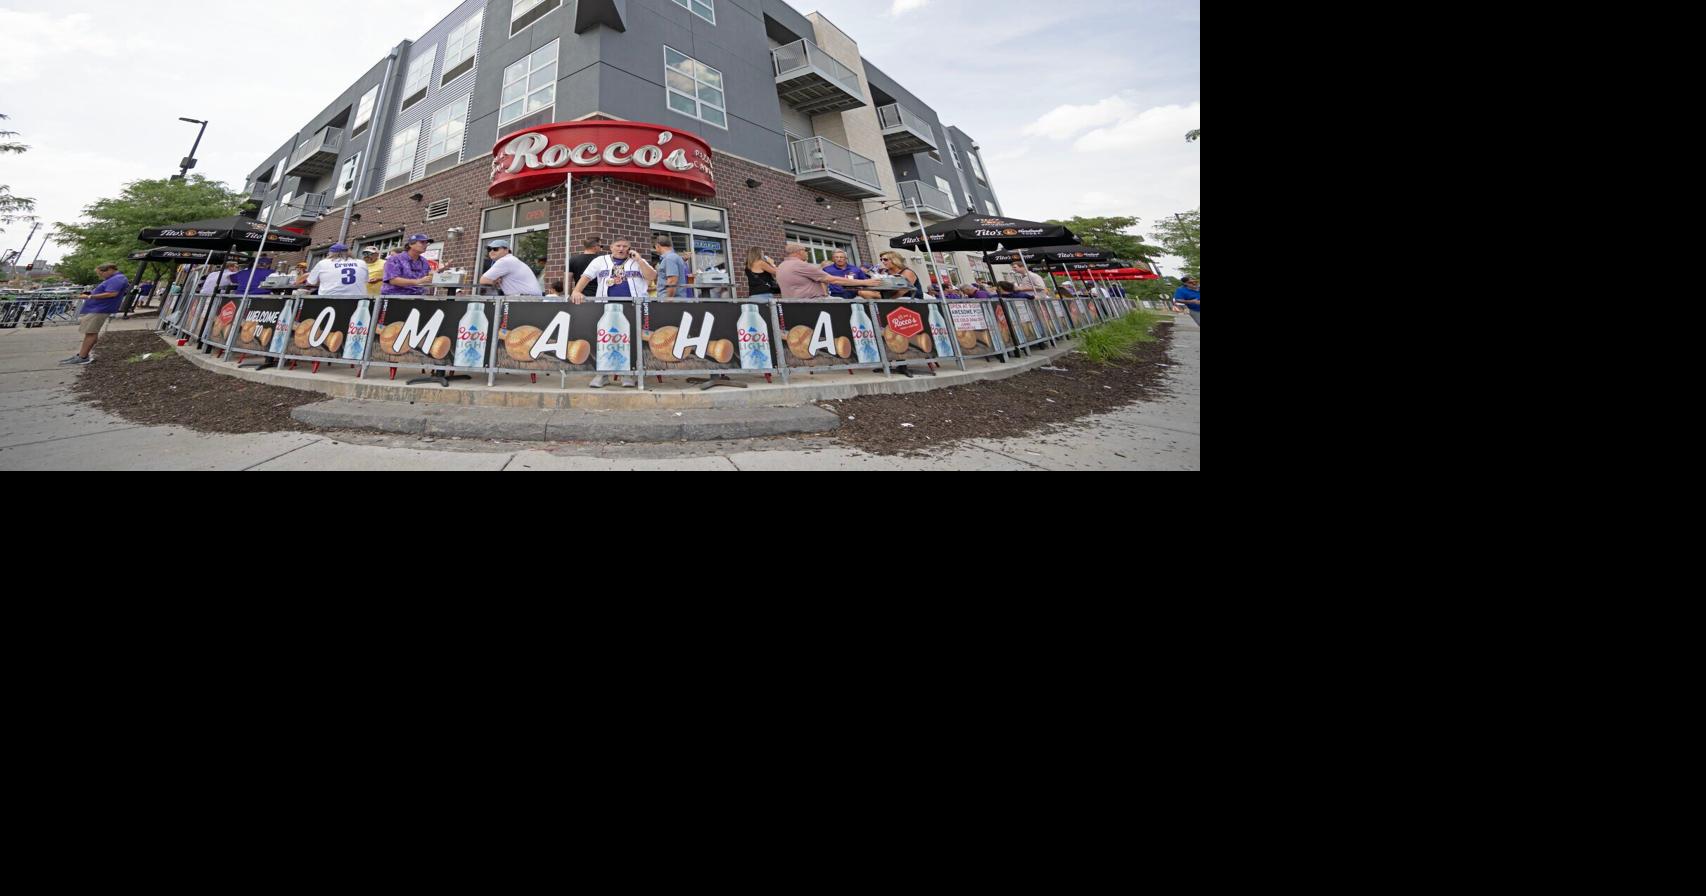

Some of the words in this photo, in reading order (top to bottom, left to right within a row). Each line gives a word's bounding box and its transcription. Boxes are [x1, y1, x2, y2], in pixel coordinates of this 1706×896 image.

[504, 131, 694, 174] Rocco's
[160, 229, 184, 237] Tito's
[902, 236, 920, 245] Tito's
[341, 267, 357, 285] 3
[246, 310, 280, 324] WELCOME
[892, 317, 917, 328] Rocco's
[253, 324, 264, 337] TO
[308, 306, 336, 347] O
[392, 308, 445, 355] M
[529, 310, 571, 361] A
[672, 311, 715, 360] H
[808, 311, 837, 357] A
